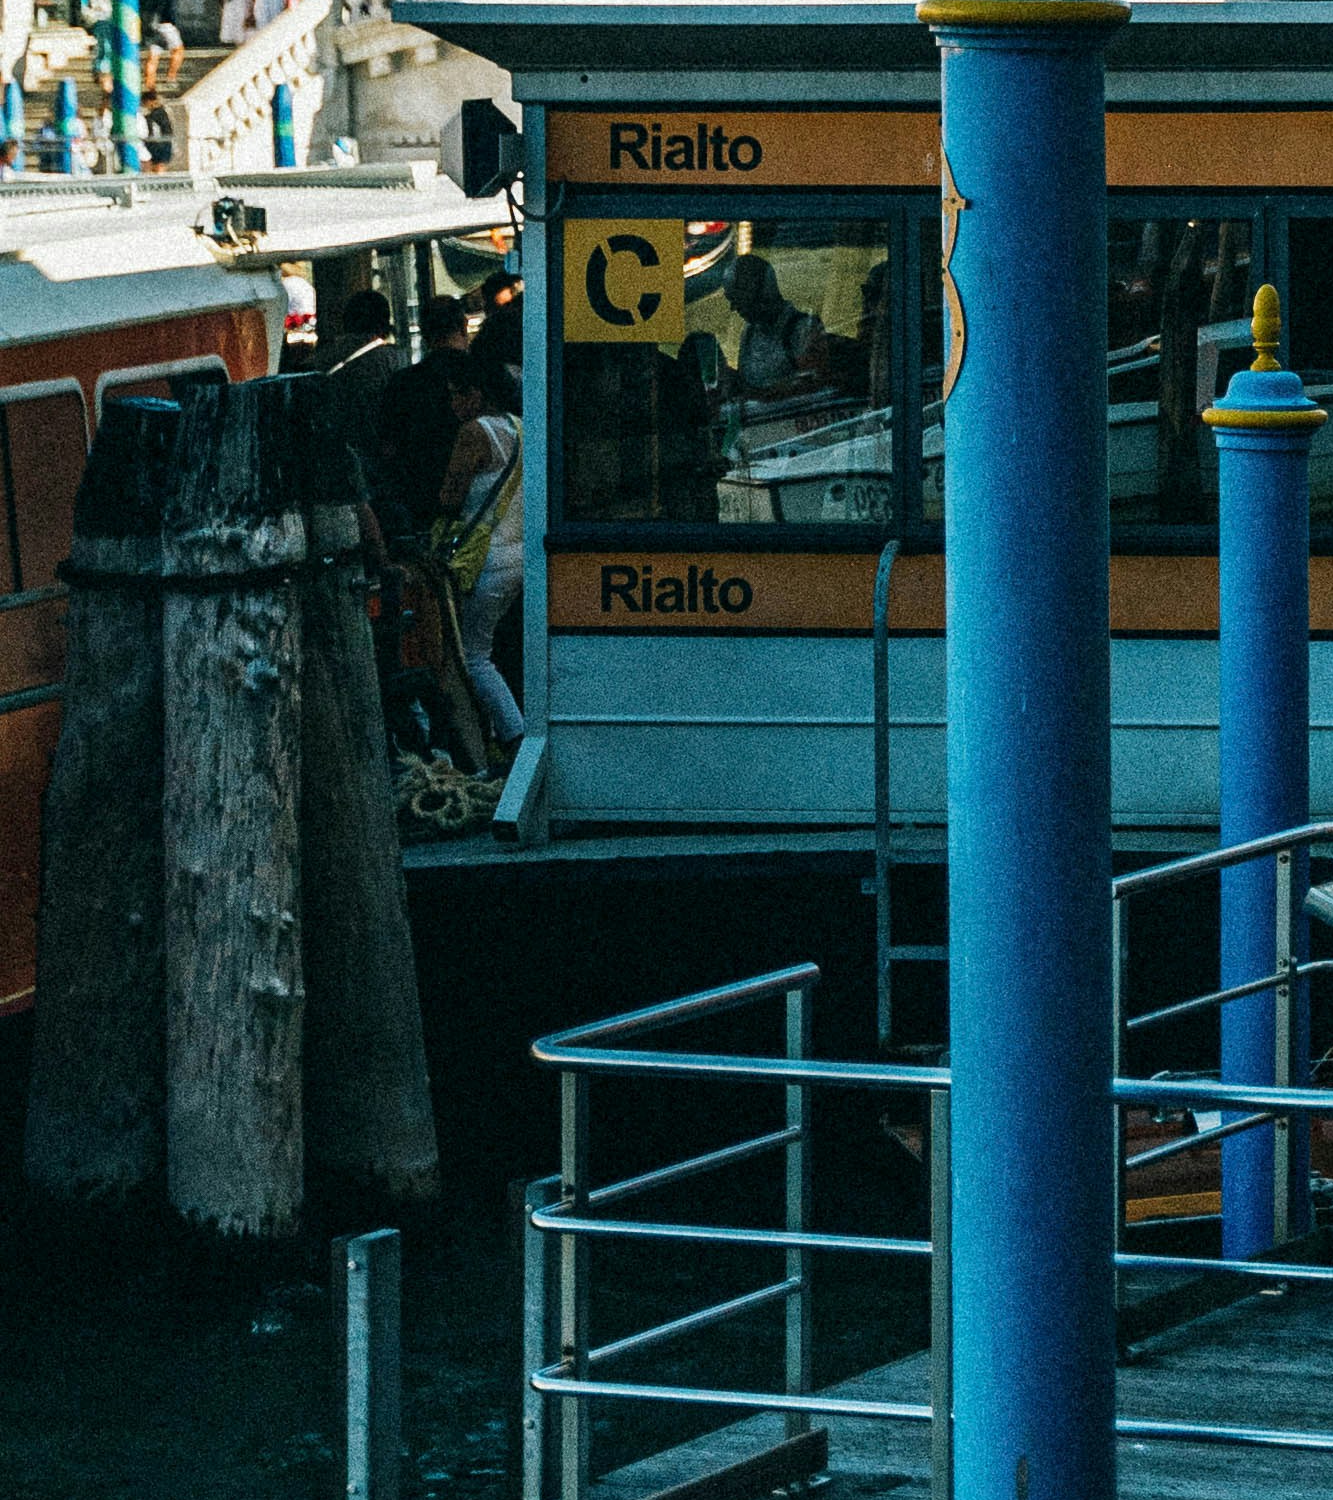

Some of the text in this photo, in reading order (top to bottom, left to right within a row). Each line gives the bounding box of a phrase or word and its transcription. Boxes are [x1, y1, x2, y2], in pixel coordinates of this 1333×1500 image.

[609, 122, 763, 172] Rialto
[585, 233, 661, 327] C
[600, 565, 753, 613] Rialto
